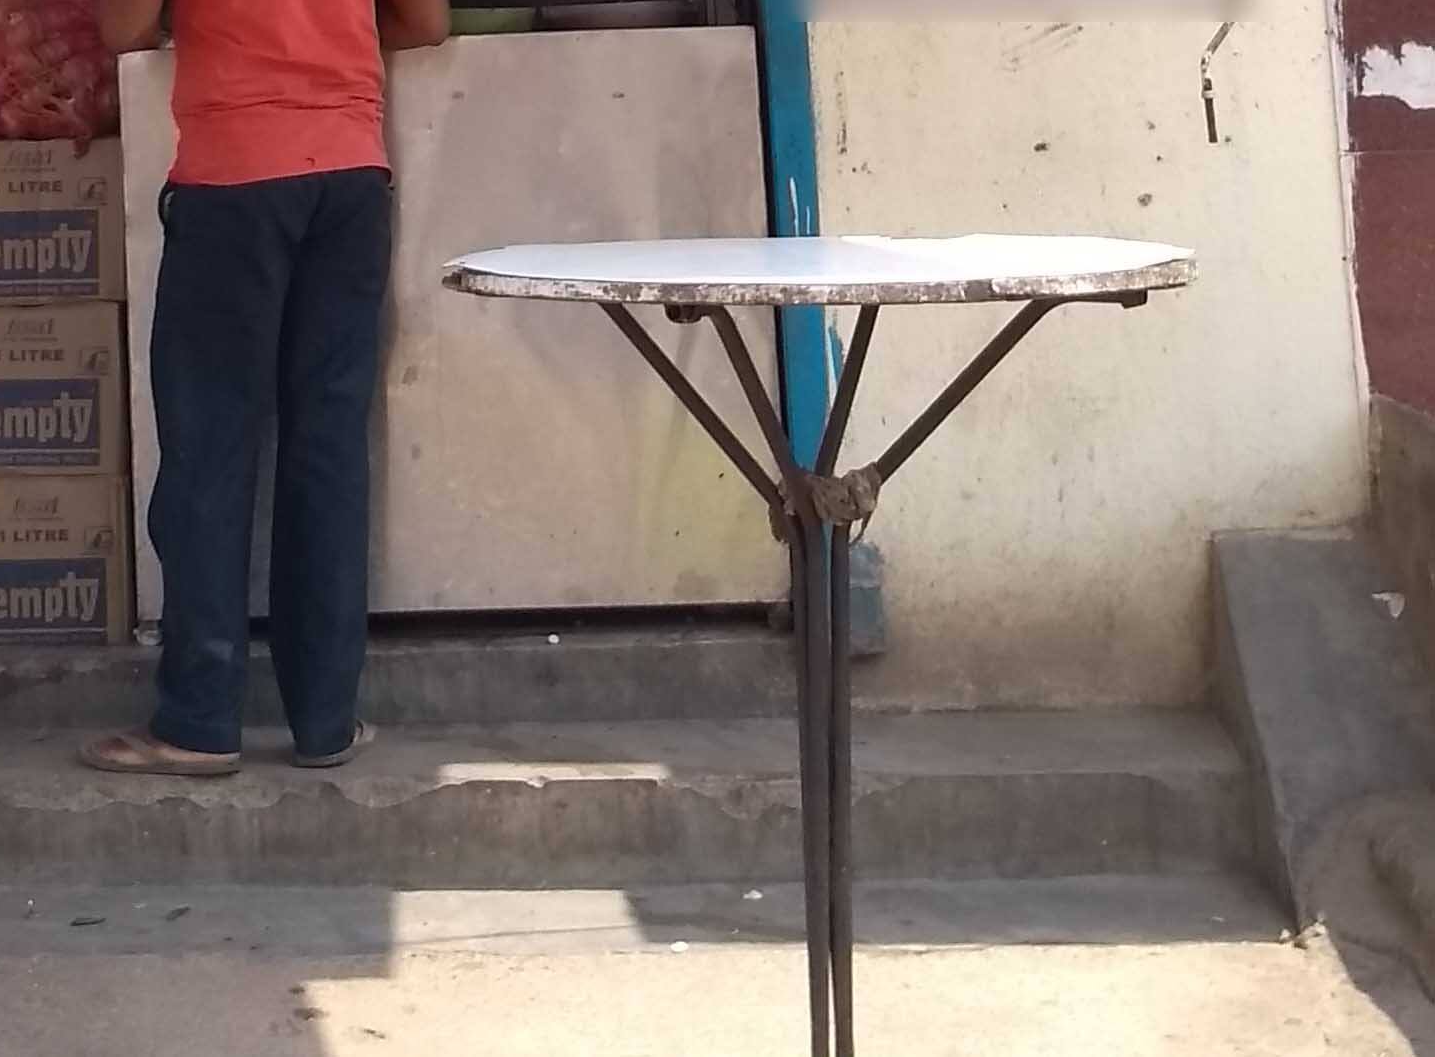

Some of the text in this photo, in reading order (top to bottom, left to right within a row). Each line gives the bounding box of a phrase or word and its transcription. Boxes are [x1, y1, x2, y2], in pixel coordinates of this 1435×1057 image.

[8, 180, 64, 193] LITRE
[9, 349, 65, 362] LITRE
[13, 529, 69, 542] LITRE
